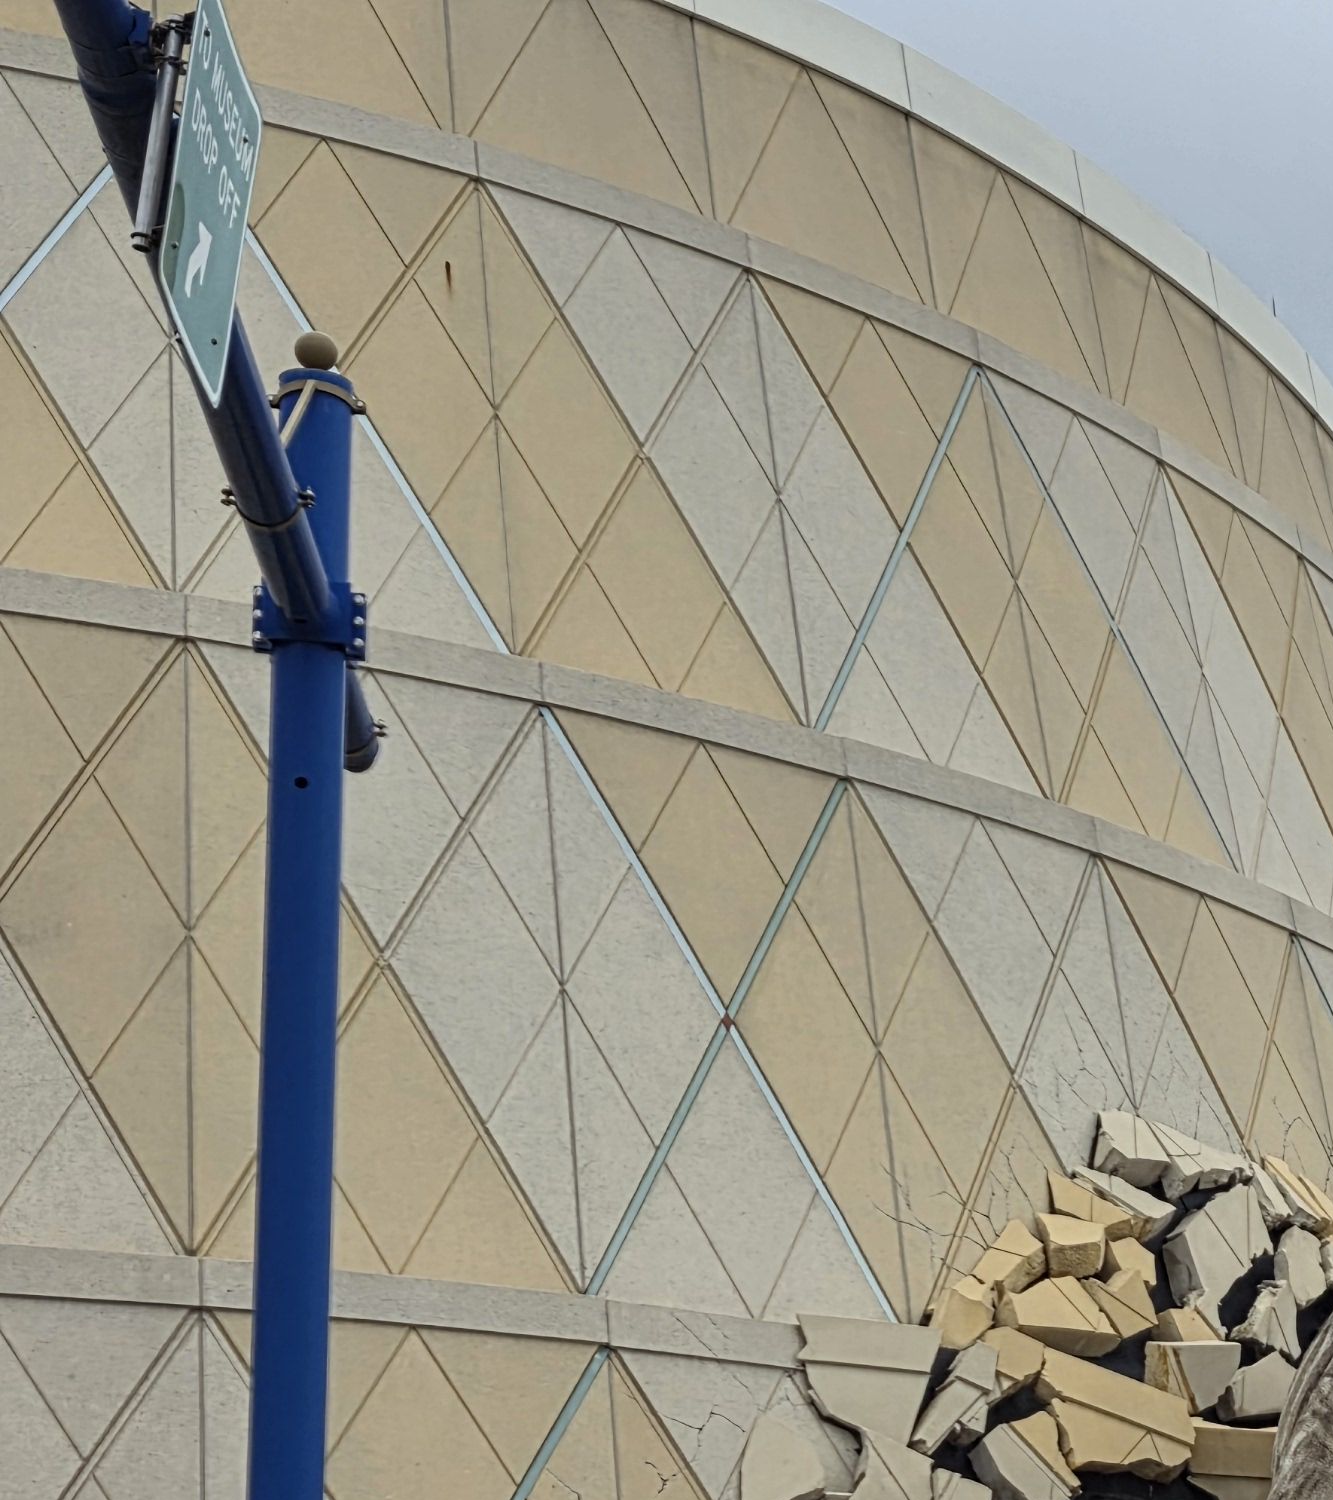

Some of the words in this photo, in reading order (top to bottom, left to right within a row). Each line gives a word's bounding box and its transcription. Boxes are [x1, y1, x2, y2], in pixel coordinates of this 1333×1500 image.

[191, 88, 218, 174] DROP
[218, 165, 241, 229] OFF
[201, 9, 212, 70] TO
[211, 52, 254, 182] MUSEUM
